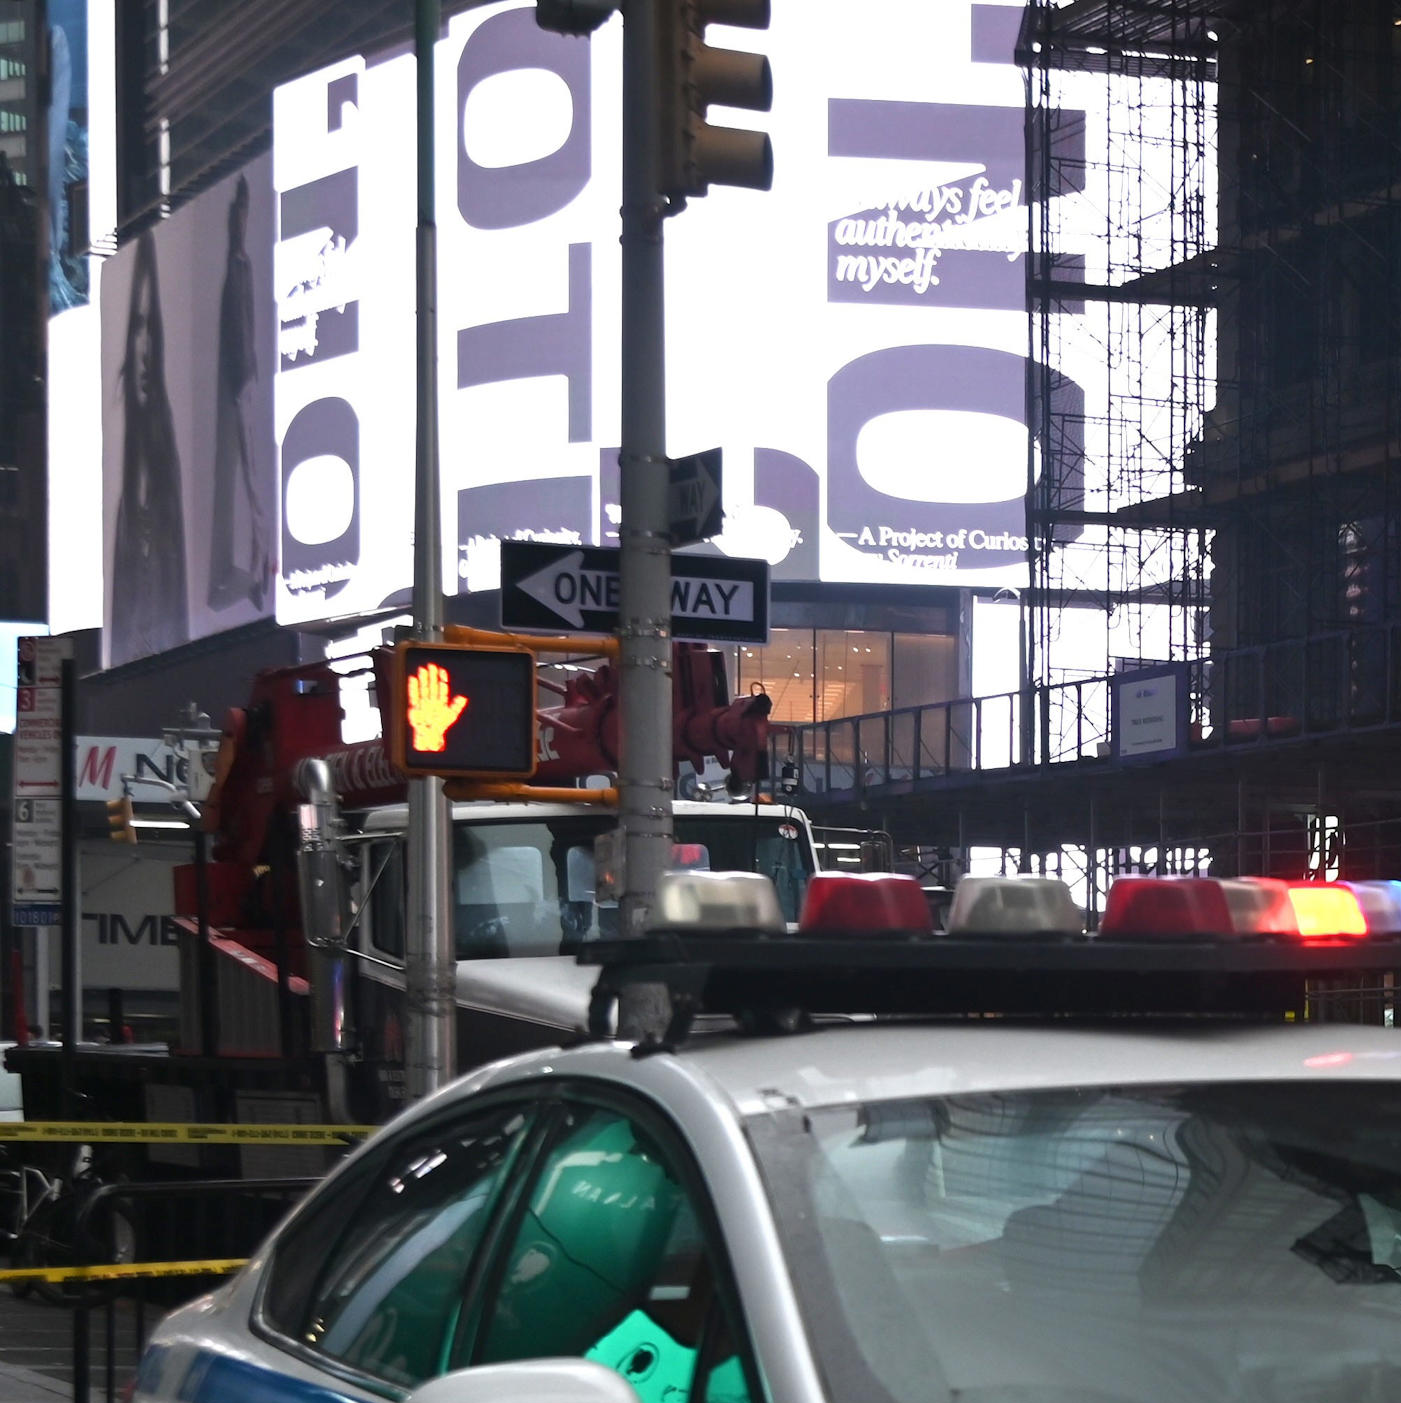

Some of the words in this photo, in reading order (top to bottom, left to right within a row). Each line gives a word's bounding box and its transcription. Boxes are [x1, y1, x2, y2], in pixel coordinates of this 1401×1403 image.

[836, 248, 942, 294] myself.
[879, 526, 944, 551] Project
[946, 529, 967, 549] of
[554, 572, 620, 607] ONE
[671, 581, 740, 615] WAY
[18, 801, 29, 821] 6
